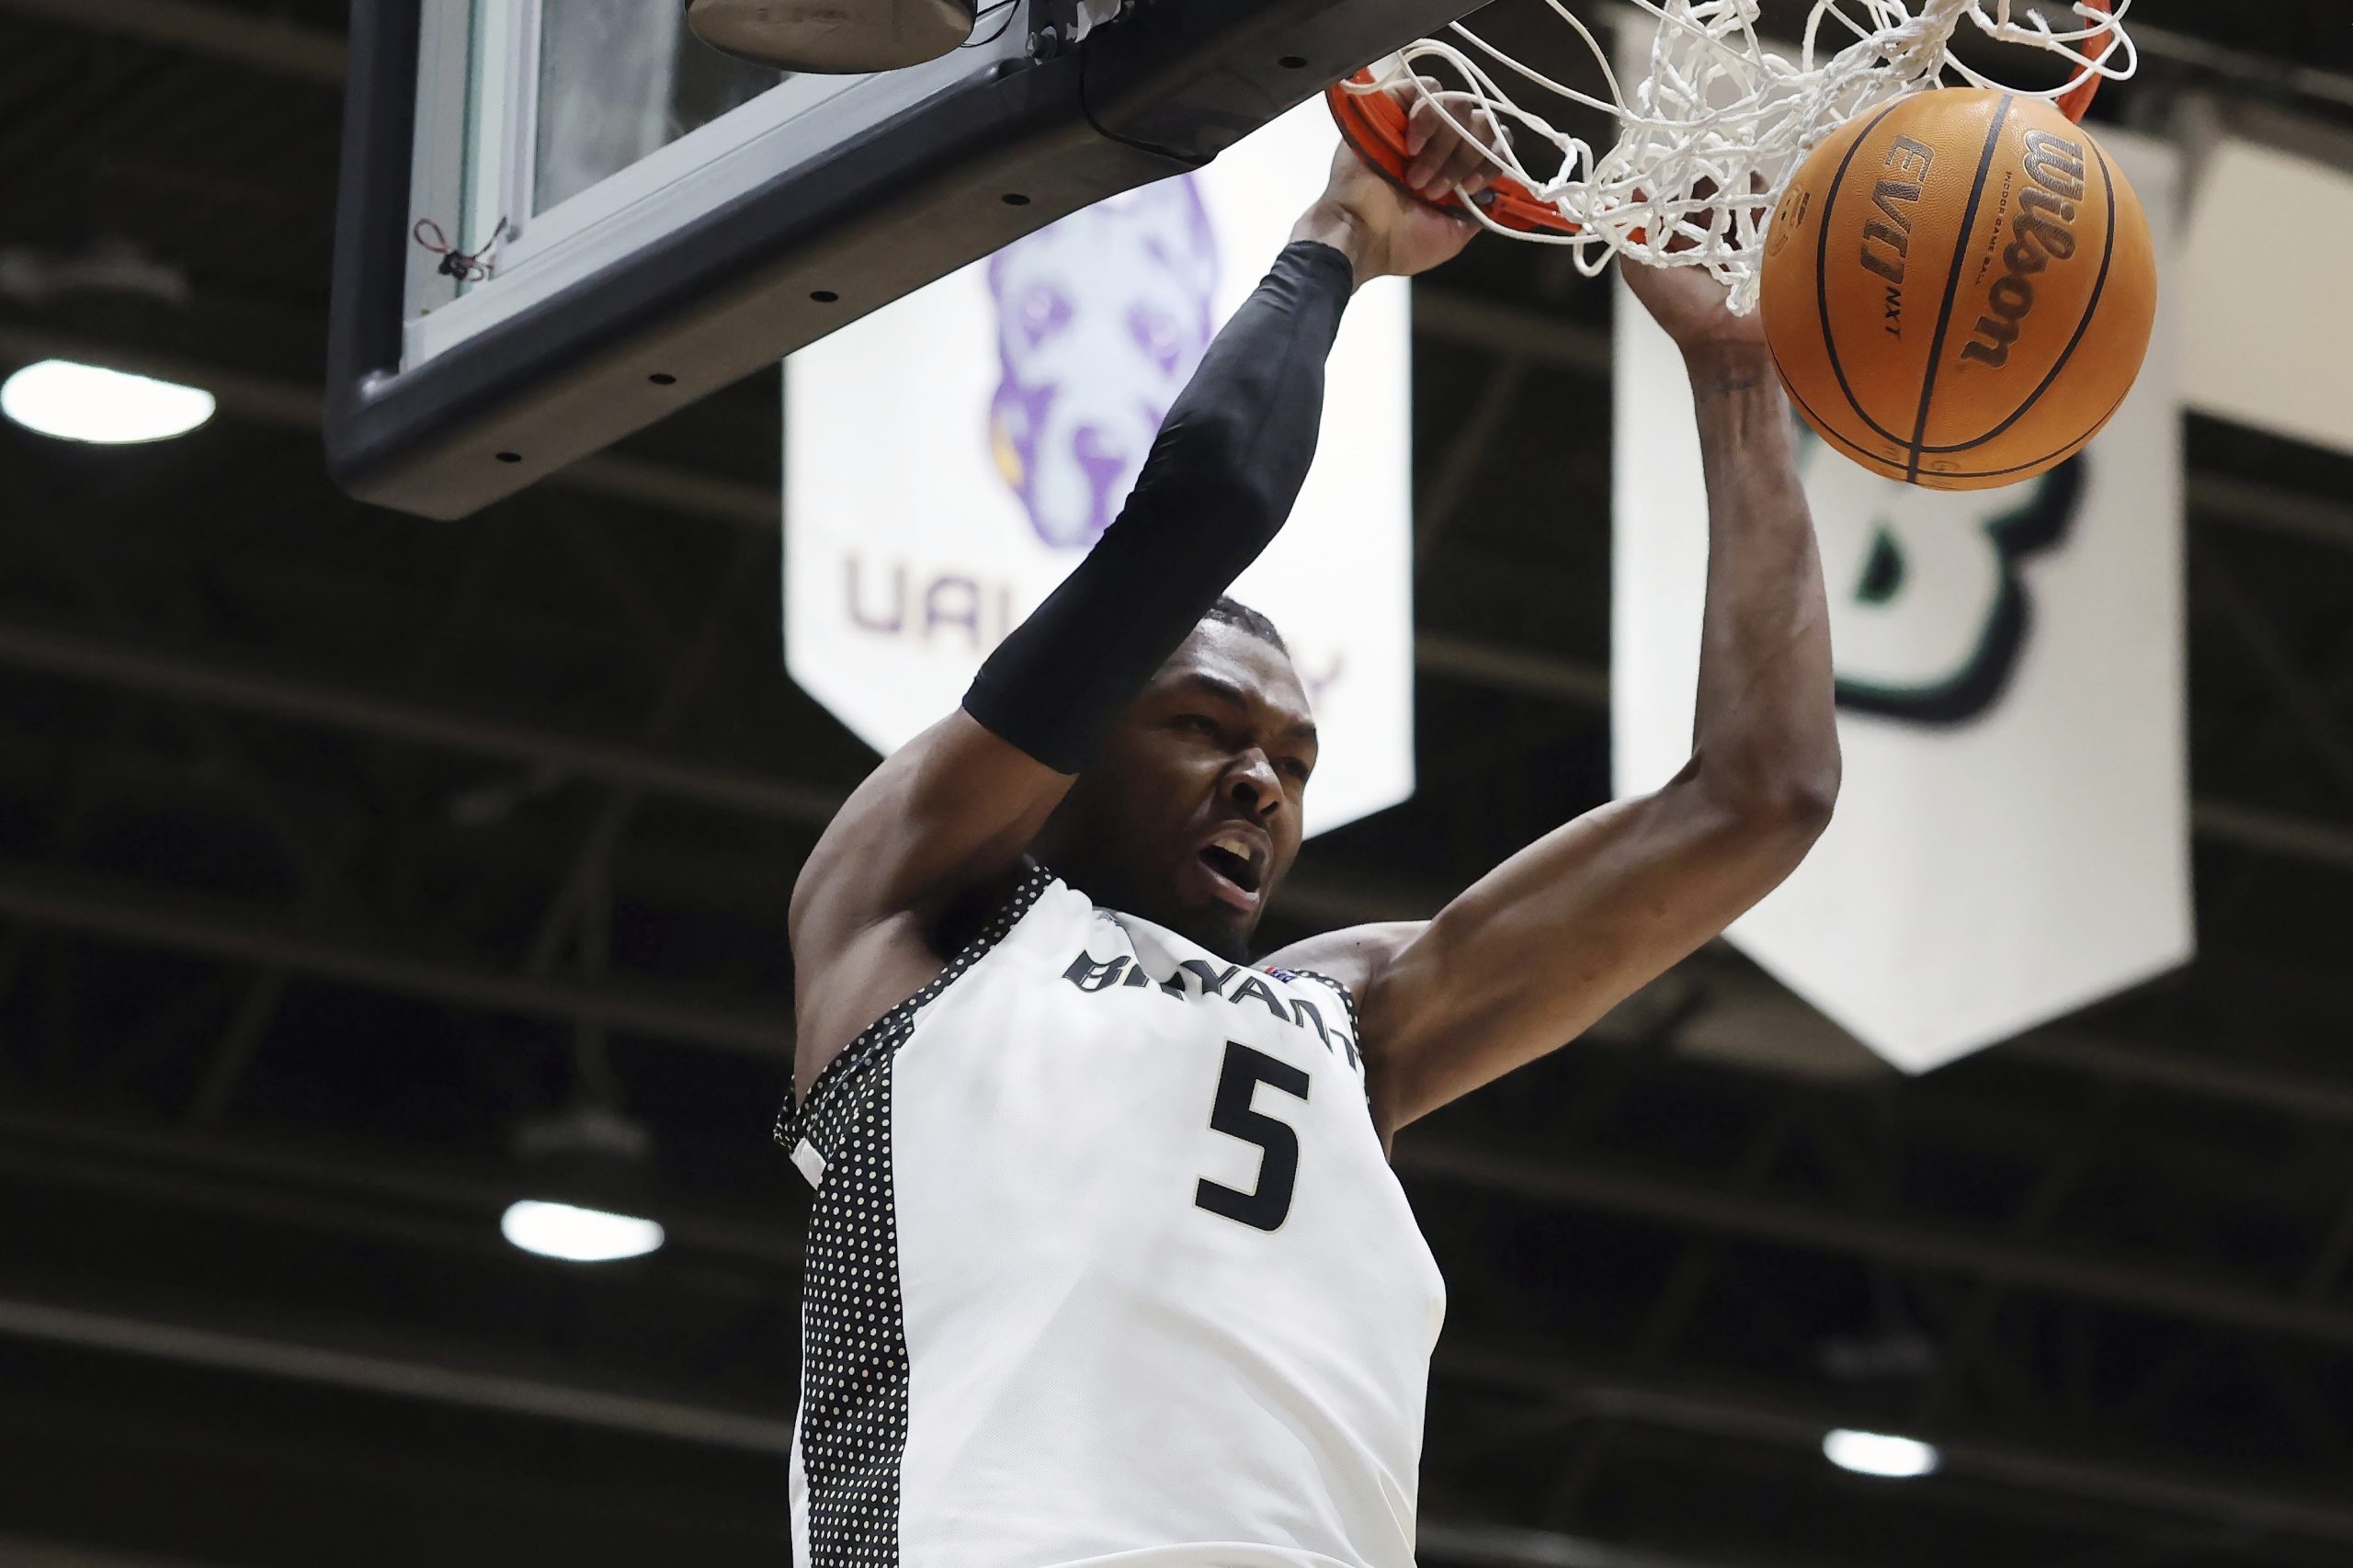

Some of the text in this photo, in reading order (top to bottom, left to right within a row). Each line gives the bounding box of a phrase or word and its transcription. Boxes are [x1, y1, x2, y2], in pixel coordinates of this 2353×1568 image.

[1860, 135, 1936, 340] EVO NXT
[1960, 129, 2086, 369] Wilson
[1974, 170, 2013, 287] INDOOR GAME BALL
[1192, 1037, 1312, 1235] 5
